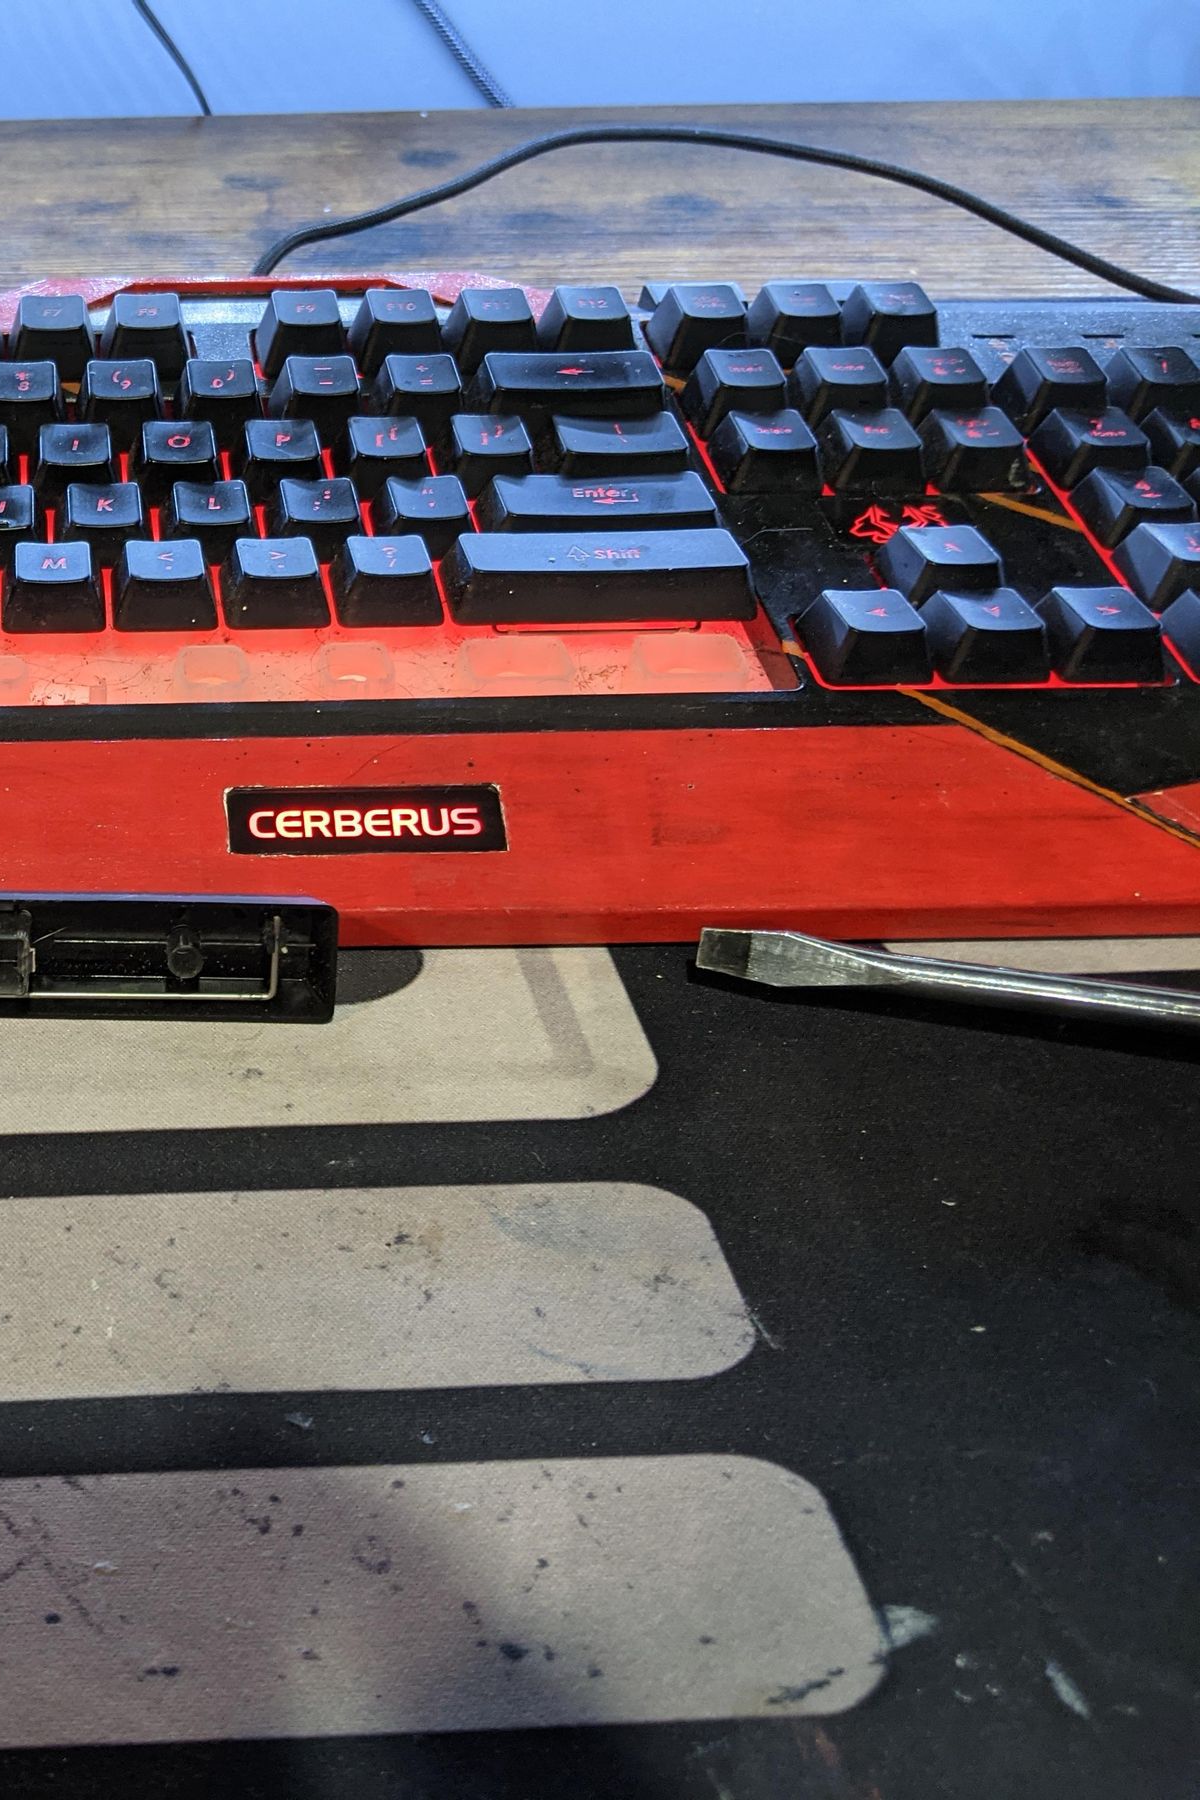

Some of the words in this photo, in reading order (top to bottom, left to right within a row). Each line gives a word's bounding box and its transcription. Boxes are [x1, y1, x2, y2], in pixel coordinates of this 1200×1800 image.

[42, 309, 63, 317] F7
[296, 304, 315, 313] F9
[17, 381, 29, 391] 8
[120, 380, 132, 390] 9
[72, 439, 79, 451] I
[167, 434, 191, 448] O
[275, 433, 292, 447] P
[572, 488, 628, 498] Enter
[97, 499, 114, 512] K
[208, 497, 221, 510] L
[594, 549, 640, 560] Shift
[41, 557, 67, 570] M
[249, 807, 482, 838] CERBERUS
